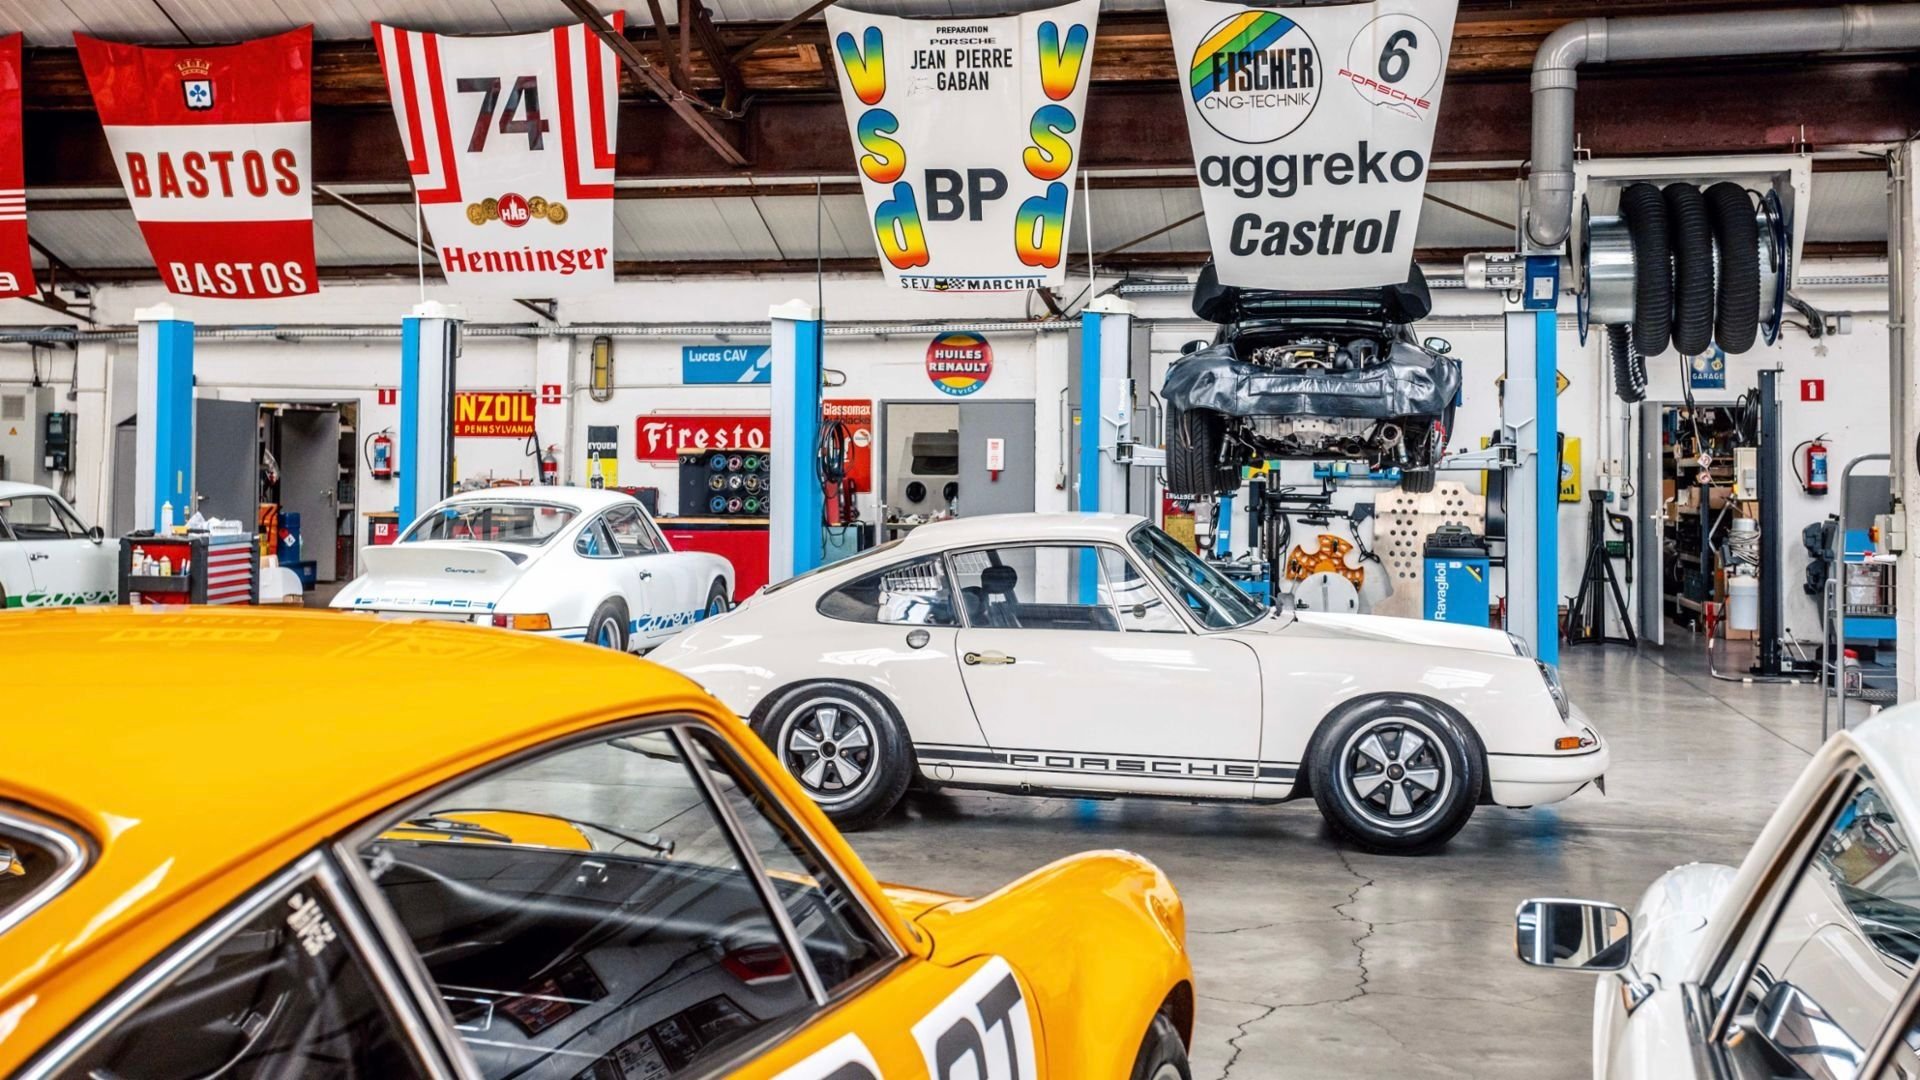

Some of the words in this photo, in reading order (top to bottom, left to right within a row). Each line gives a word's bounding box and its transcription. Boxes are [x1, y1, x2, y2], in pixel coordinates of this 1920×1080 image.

[929, 37, 996, 45] PORSCHE
[936, 26, 988, 34] PREPARATION
[911, 50, 946, 70] JEAN
[956, 49, 1013, 68] PIERRE
[1378, 29, 1418, 84] 6
[936, 71, 989, 91] GABAN
[1212, 48, 1315, 92] FISCHER
[1339, 68, 1431, 110] PORSCHE
[1204, 92, 1311, 109] CNG-TECHNIK
[456, 76, 549, 153] 74
[127, 148, 301, 198] BASTOS
[1200, 141, 1424, 198] aggreko
[924, 168, 1009, 222] BP
[1230, 210, 1401, 256] Castrol
[443, 246, 608, 275] Henninger
[170, 261, 307, 294] BASTOS
[967, 278, 1045, 290] MARCHAL
[689, 350, 721, 362] Lucas
[723, 350, 747, 362] CAV
[935, 350, 982, 359] HUILES
[929, 363, 988, 372] RENAULT
[940, 384, 978, 395] SERVICE
[823, 403, 871, 416] Glassomax
[465, 425, 533, 434] PENNSYLVANIA
[1435, 562, 1449, 620] Ravaglioli
[1008, 753, 1258, 777] PORSCHE
